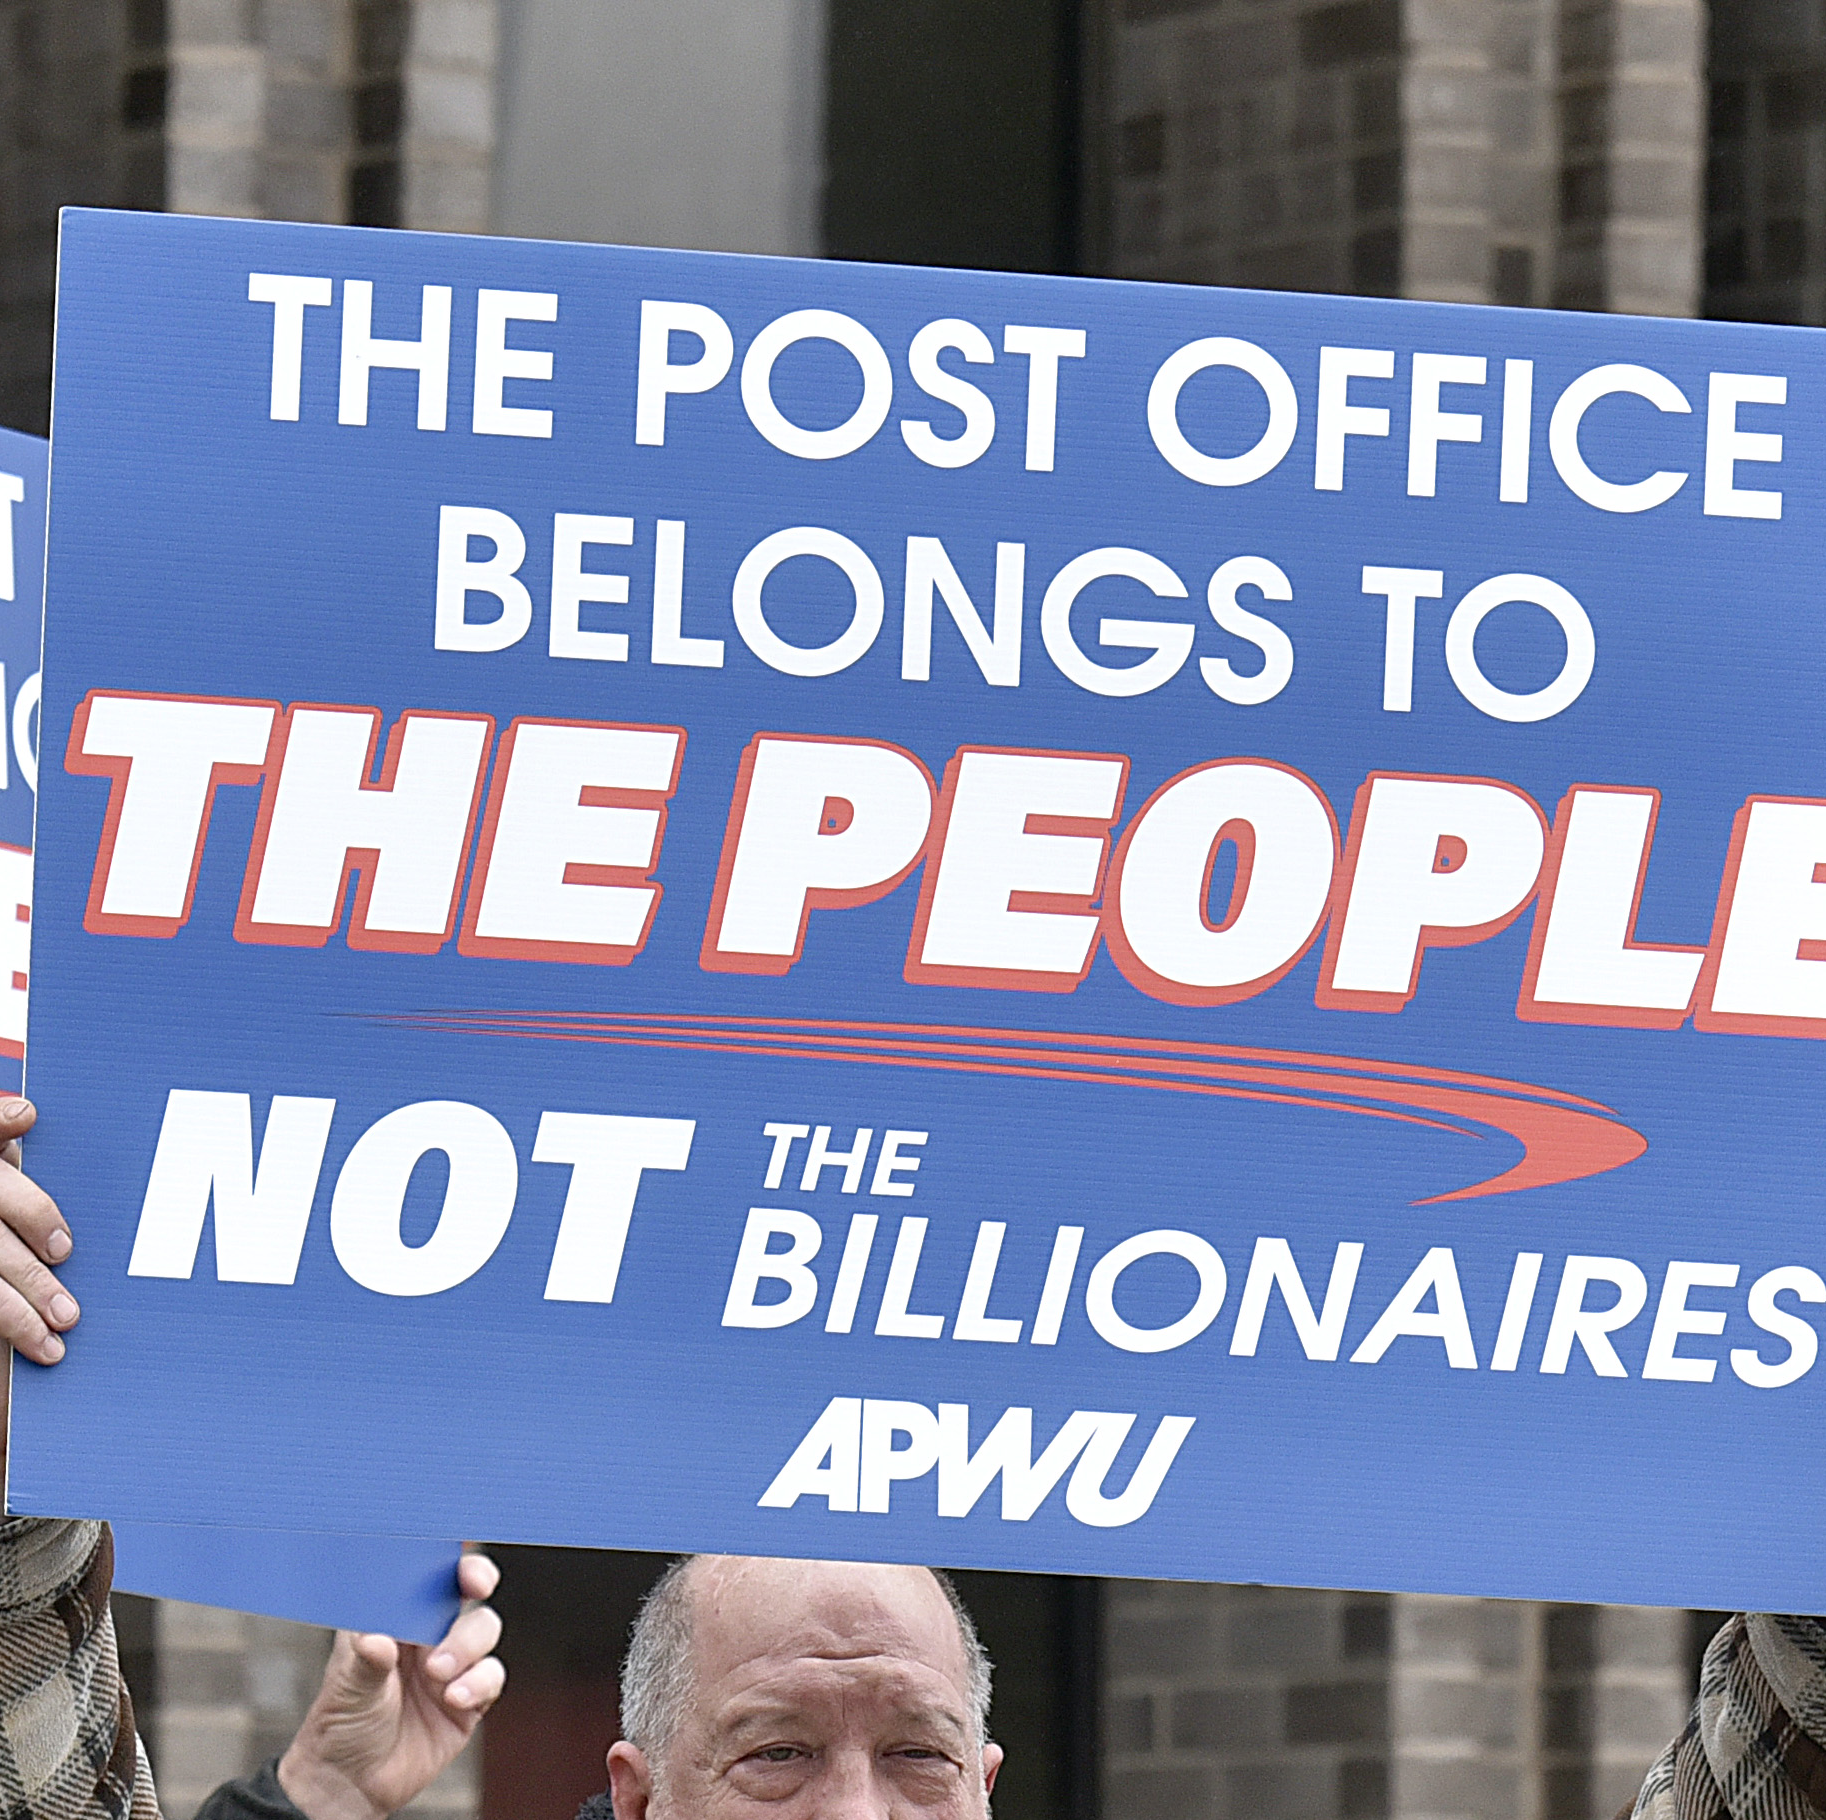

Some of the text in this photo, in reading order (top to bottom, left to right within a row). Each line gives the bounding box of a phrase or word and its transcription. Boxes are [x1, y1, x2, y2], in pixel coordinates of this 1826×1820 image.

[248, 273, 1787, 519] THE POST OFFICE
[435, 505, 1595, 722] BELONGS TO
[65, 690, 686, 964] THE
[128, 1089, 696, 1303] NOT
[764, 1123, 928, 1196] THE
[723, 1213, 1826, 1388] BILLIONAIRES
[757, 1397, 1196, 1527] APWU
